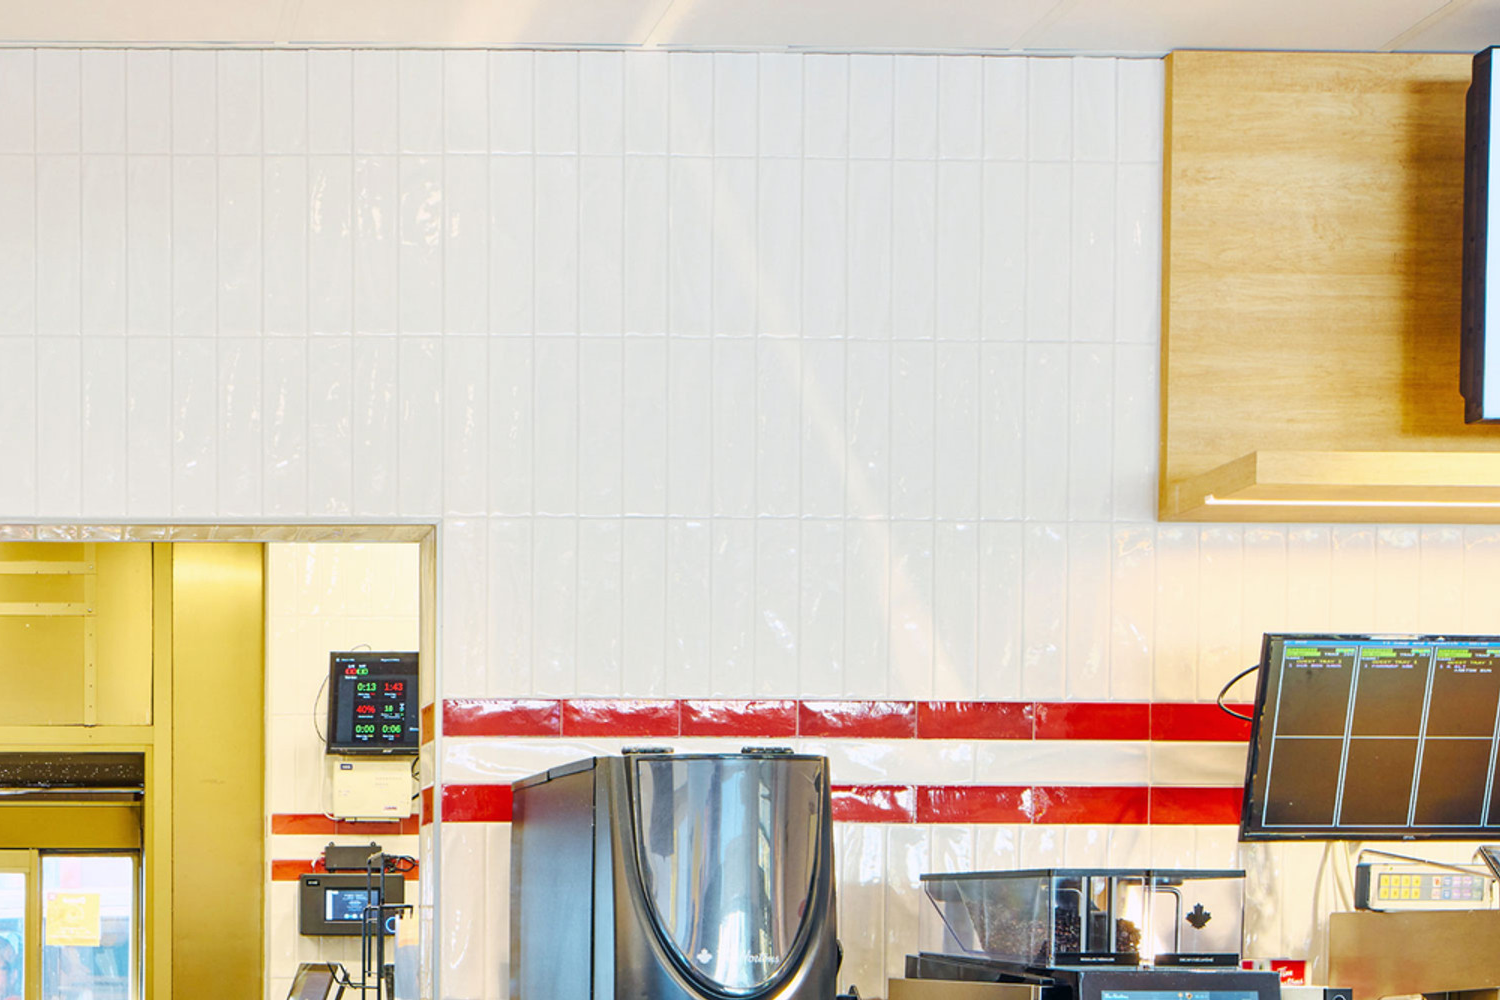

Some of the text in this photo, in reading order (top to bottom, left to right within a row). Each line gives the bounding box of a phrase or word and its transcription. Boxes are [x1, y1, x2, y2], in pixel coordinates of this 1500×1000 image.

[357, 682, 403, 692] 0:13 1:43
[355, 724, 375, 734] 0:00
